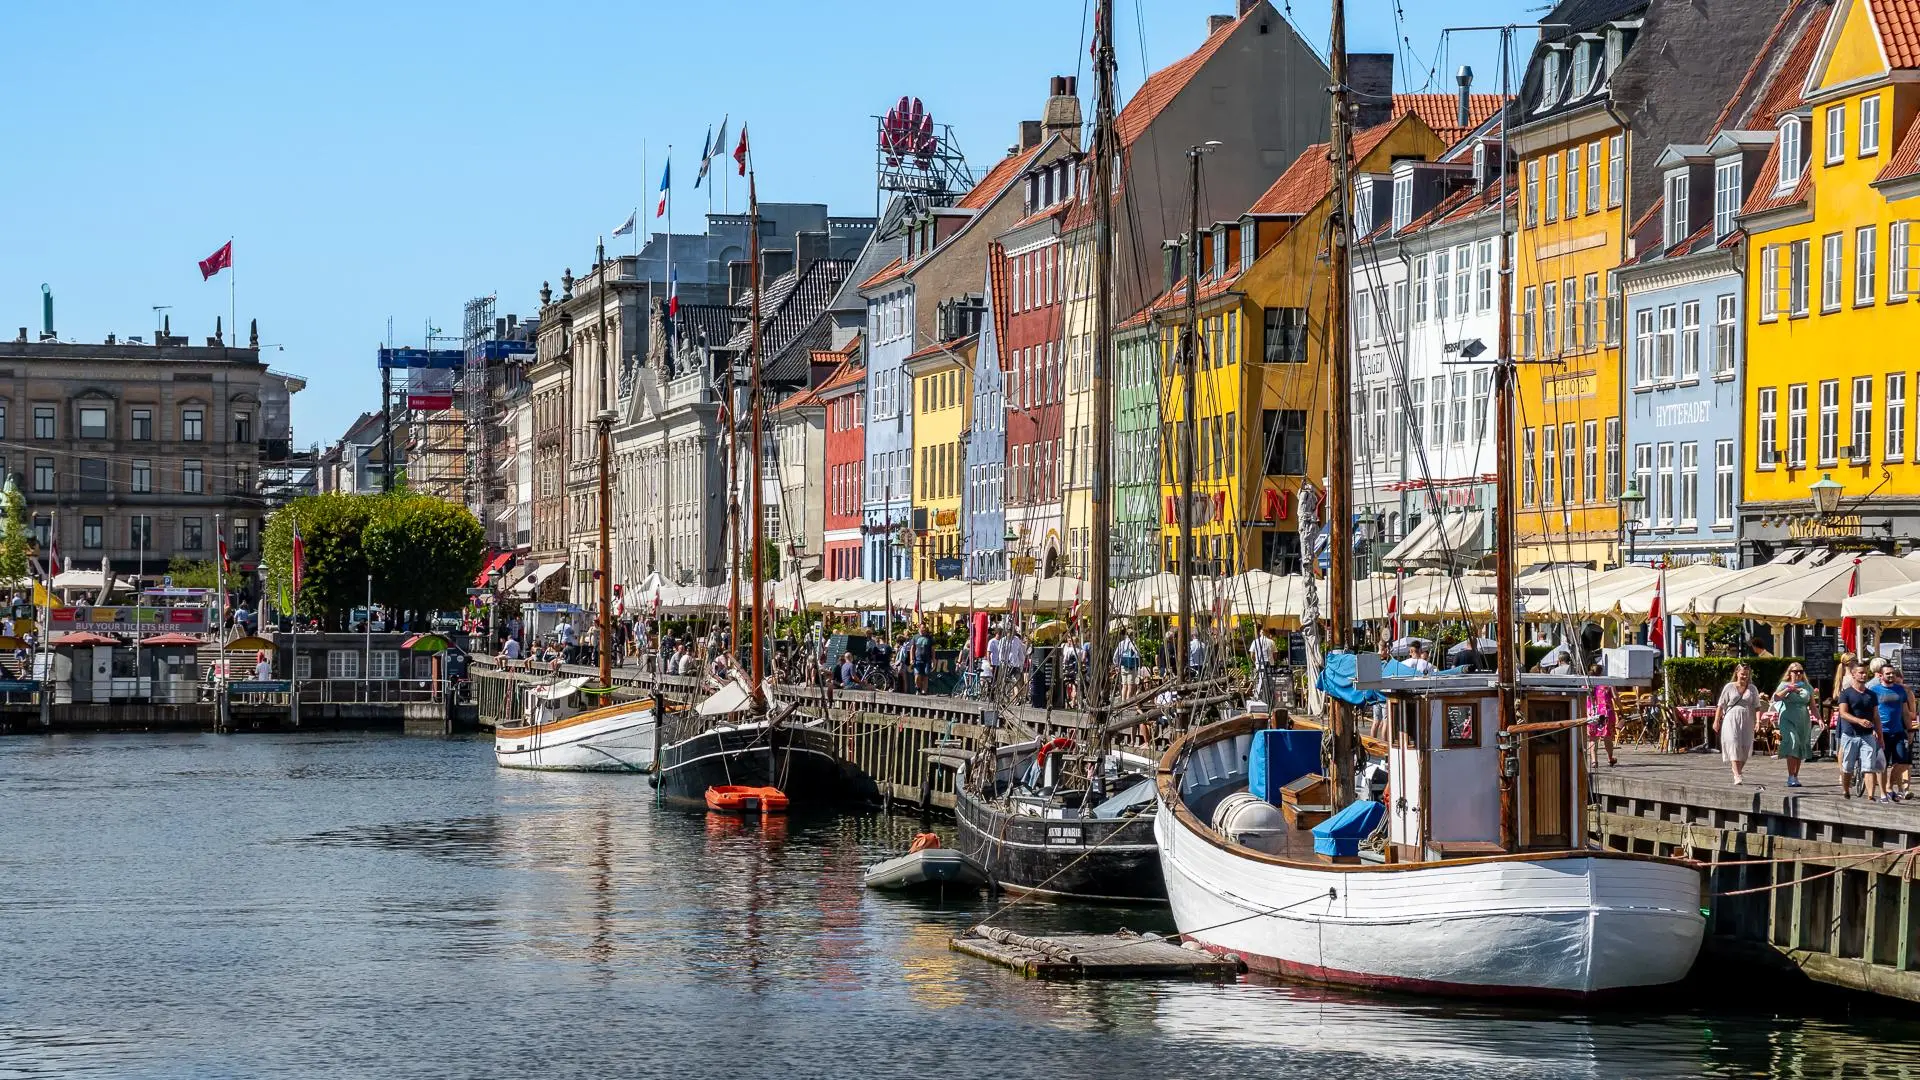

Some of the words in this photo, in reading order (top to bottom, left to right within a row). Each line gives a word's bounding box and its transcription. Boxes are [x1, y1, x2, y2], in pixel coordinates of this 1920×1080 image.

[1655, 400, 1711, 428] HYTTEFADET
[76, 622, 93, 630] BUY
[96, 622, 120, 630] YOUR
[123, 623, 157, 631] TICETS
[158, 623, 180, 631] HERE
